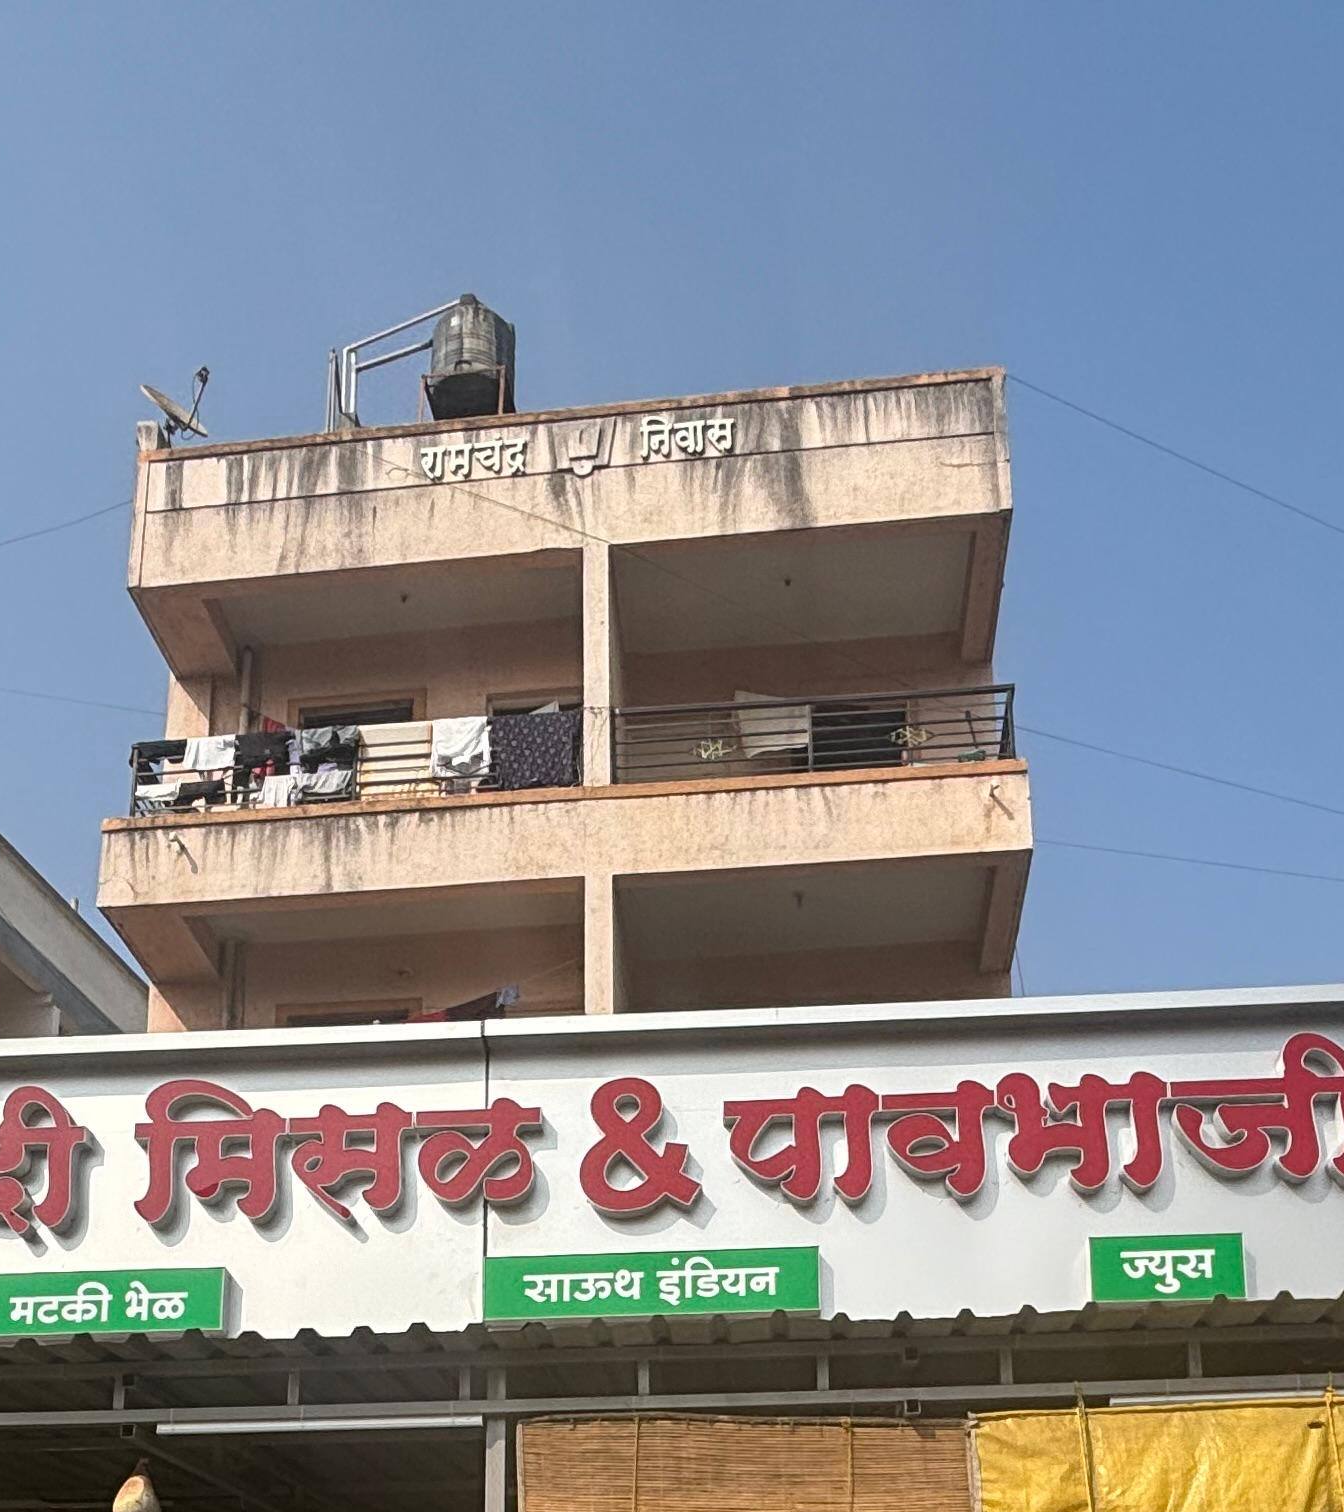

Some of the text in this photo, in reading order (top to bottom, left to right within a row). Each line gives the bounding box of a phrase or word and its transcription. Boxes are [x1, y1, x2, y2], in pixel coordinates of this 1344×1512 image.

[420, 415, 736, 483] रामचंद्र निवास
[132, 1078, 541, 1223] मिसळ
[578, 1077, 700, 1211] &
[523, 1260, 779, 1303] साऊथ इंडियन
[1120, 1247, 1217, 1295] ज्युस
[9, 1283, 111, 1324] मटकी
[125, 1286, 189, 1323] भेळ
